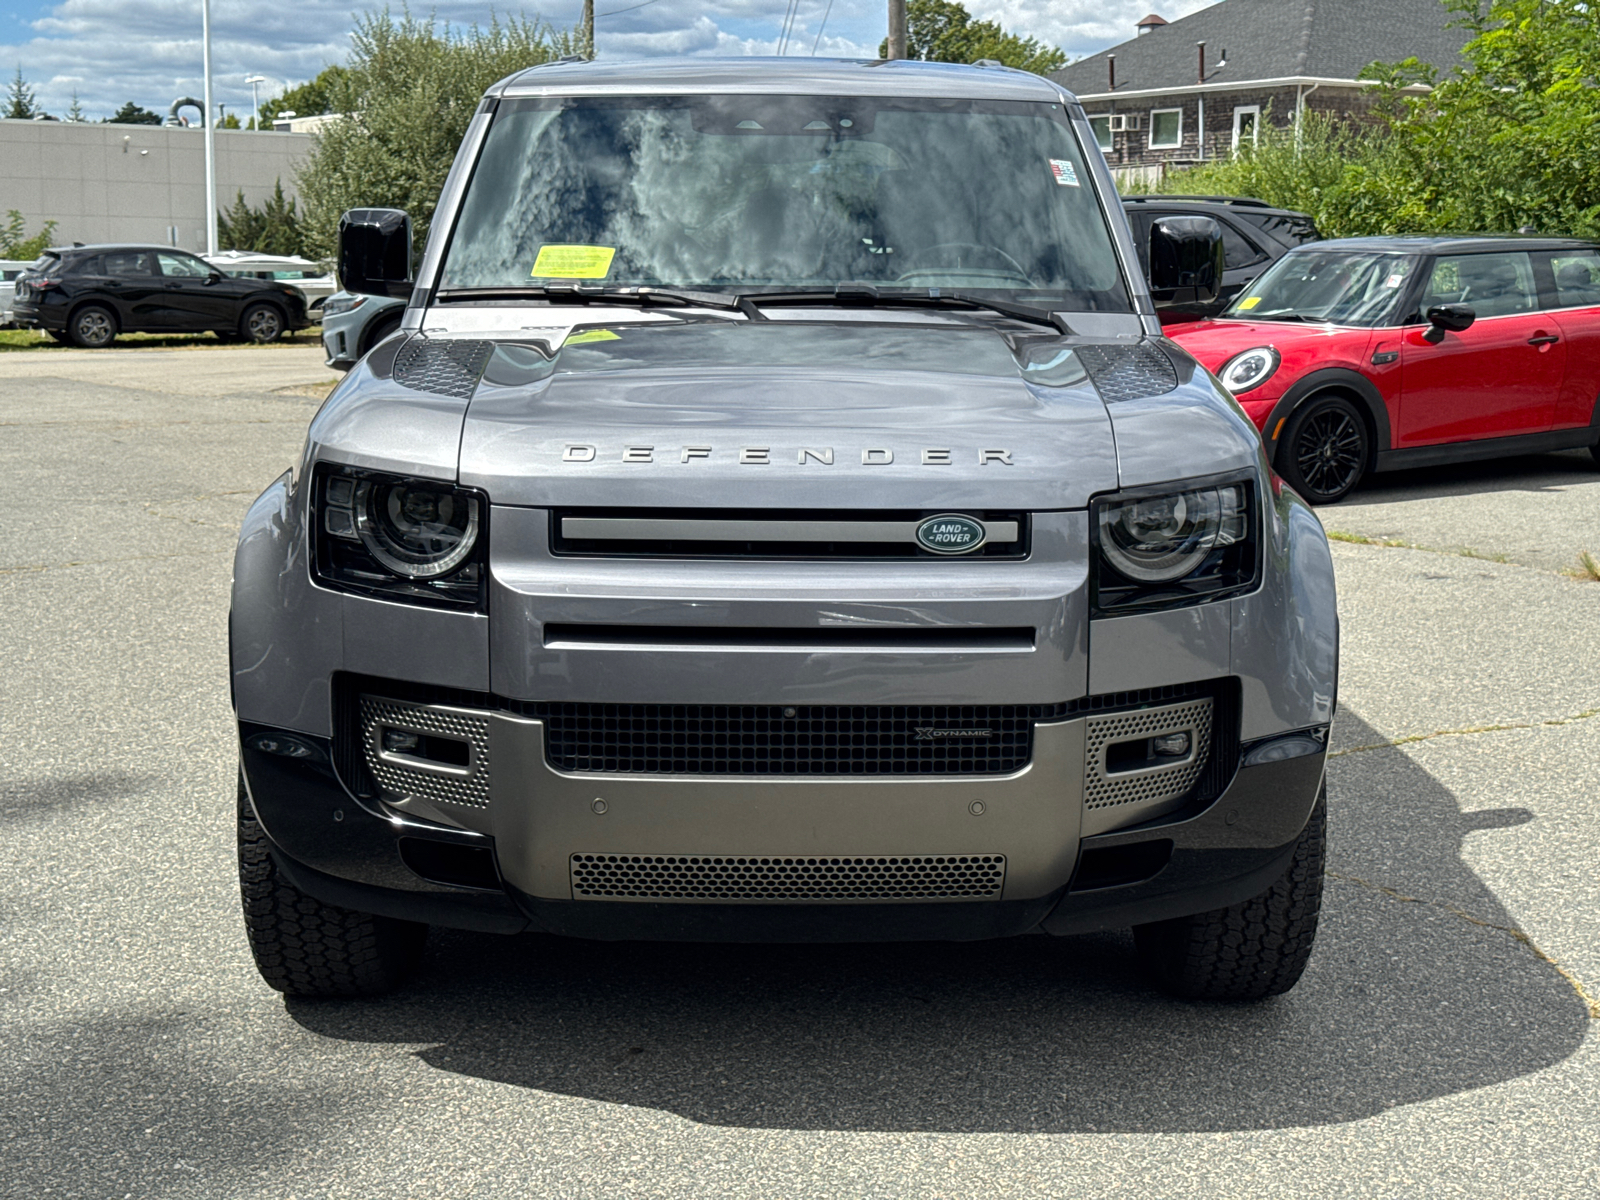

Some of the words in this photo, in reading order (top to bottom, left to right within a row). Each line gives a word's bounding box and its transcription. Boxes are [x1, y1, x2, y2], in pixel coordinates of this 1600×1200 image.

[562, 444, 1014, 465] DEFENDER
[932, 524, 962, 533] LAND
[935, 533, 971, 543] ROVER
